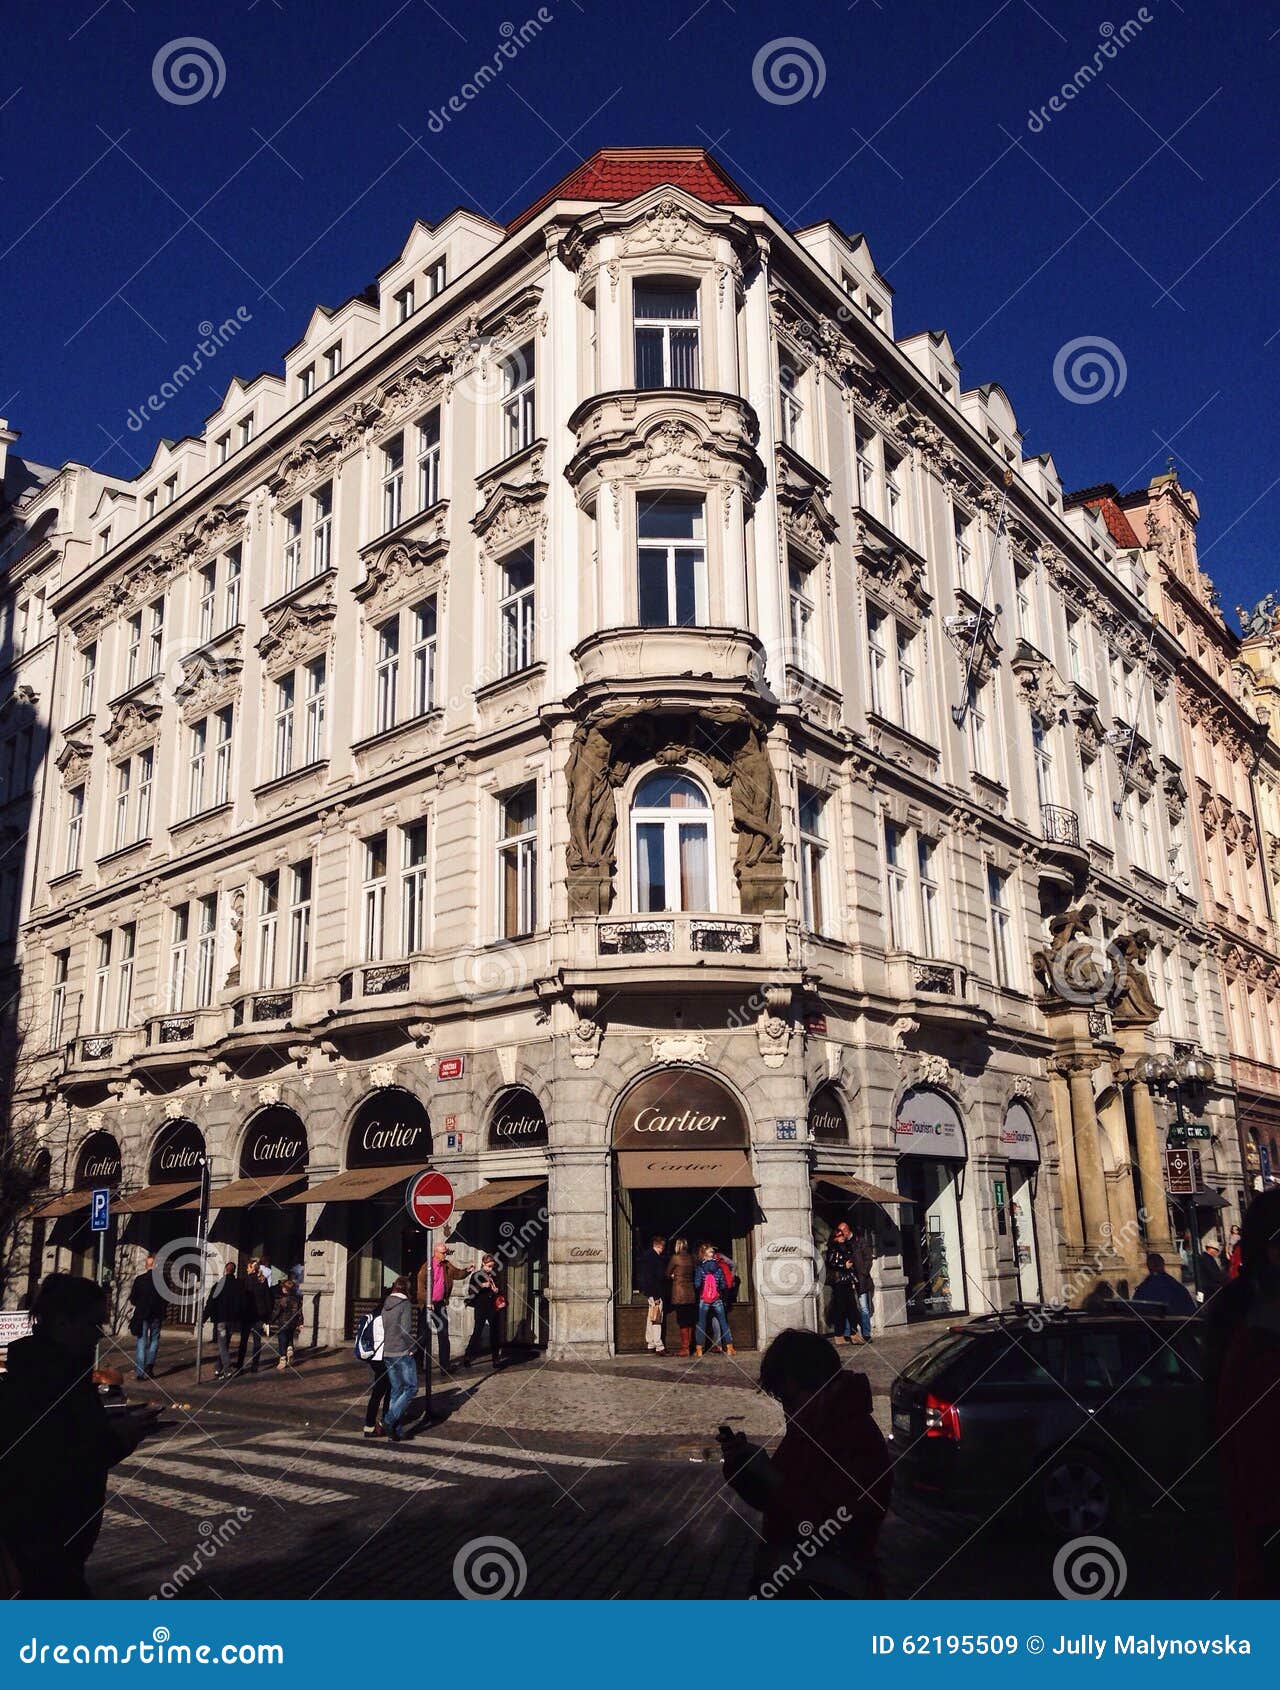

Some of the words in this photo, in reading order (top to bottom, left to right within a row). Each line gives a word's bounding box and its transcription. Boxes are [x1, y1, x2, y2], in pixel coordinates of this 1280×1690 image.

[496, 1115, 543, 1135] Cartier
[634, 1107, 726, 1132] Cartier
[812, 1109, 841, 1128] artier
[363, 1121, 421, 1149] Cartier
[161, 1146, 201, 1169] Cartier
[254, 1135, 301, 1160] Cartier
[84, 1155, 119, 1176] Cartier
[95, 1194, 105, 1217] P
[571, 1247, 602, 1256] Cartier
[767, 1243, 797, 1253] Cartier
